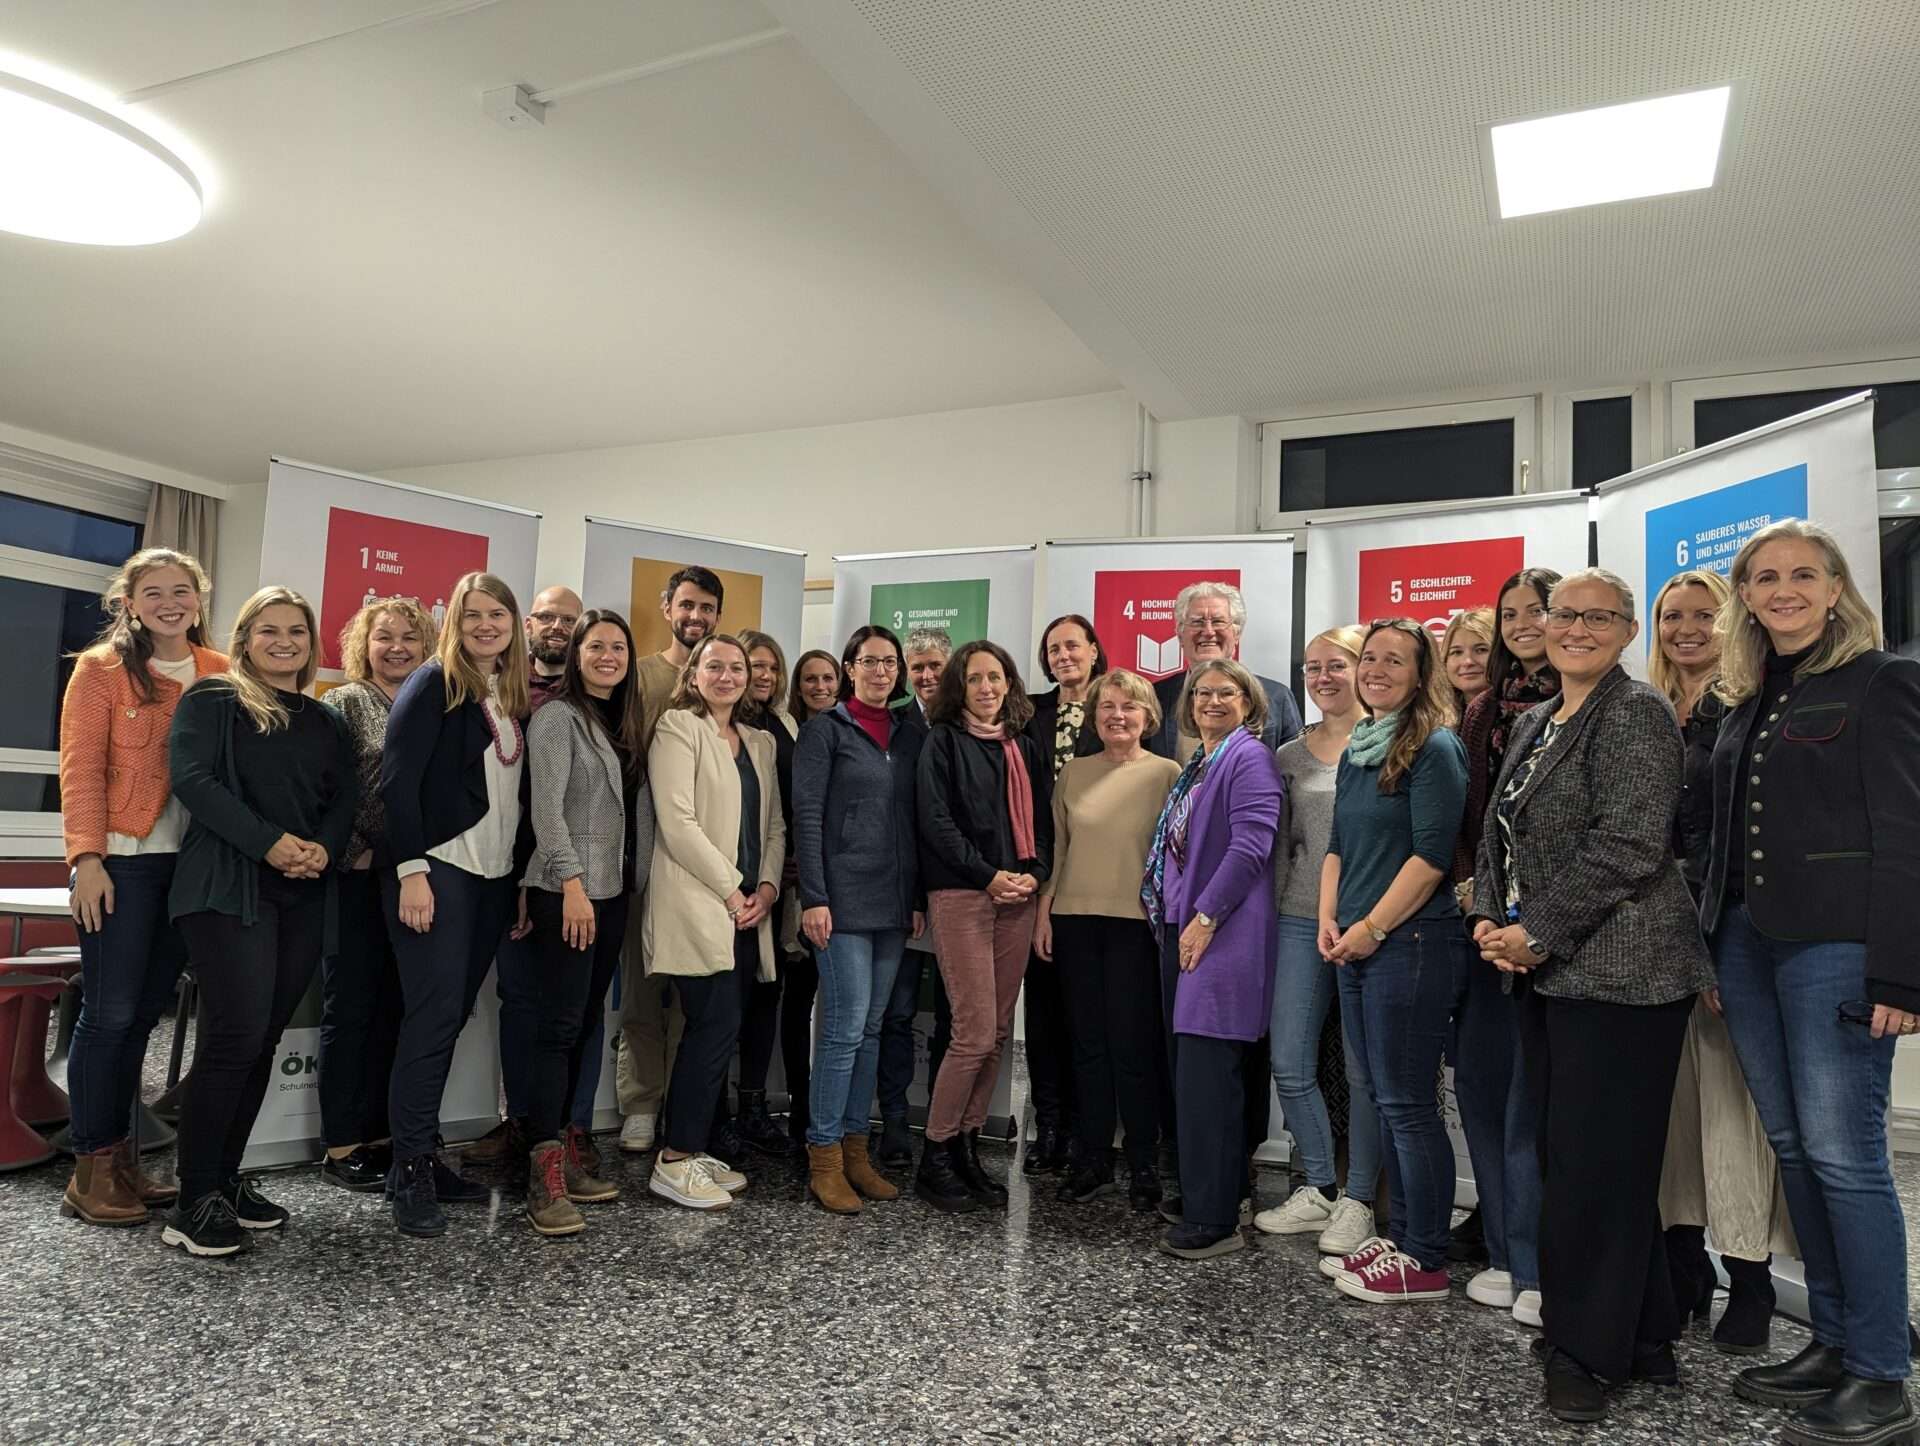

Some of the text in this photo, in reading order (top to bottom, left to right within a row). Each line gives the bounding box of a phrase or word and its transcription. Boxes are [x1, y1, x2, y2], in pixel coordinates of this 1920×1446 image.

[1695, 514, 1771, 544] SAUBERES WASSER
[360, 546, 369, 569] 1
[376, 549, 399, 562] KEINE
[1676, 539, 1689, 567] 6
[1696, 546, 1712, 560] UND
[375, 562, 404, 575] ARMUT
[1410, 575, 1476, 589] GESCHLECHTER-
[1390, 580, 1403, 603] 5
[1410, 590, 1457, 602] GLEICHHEIT
[908, 608, 959, 619] GESUNDHEIT UND
[1123, 600, 1136, 620] 4
[1141, 611, 1173, 620] BILDUNG
[893, 610, 904, 630] 3
[280, 1081, 320, 1092] Schulnet
